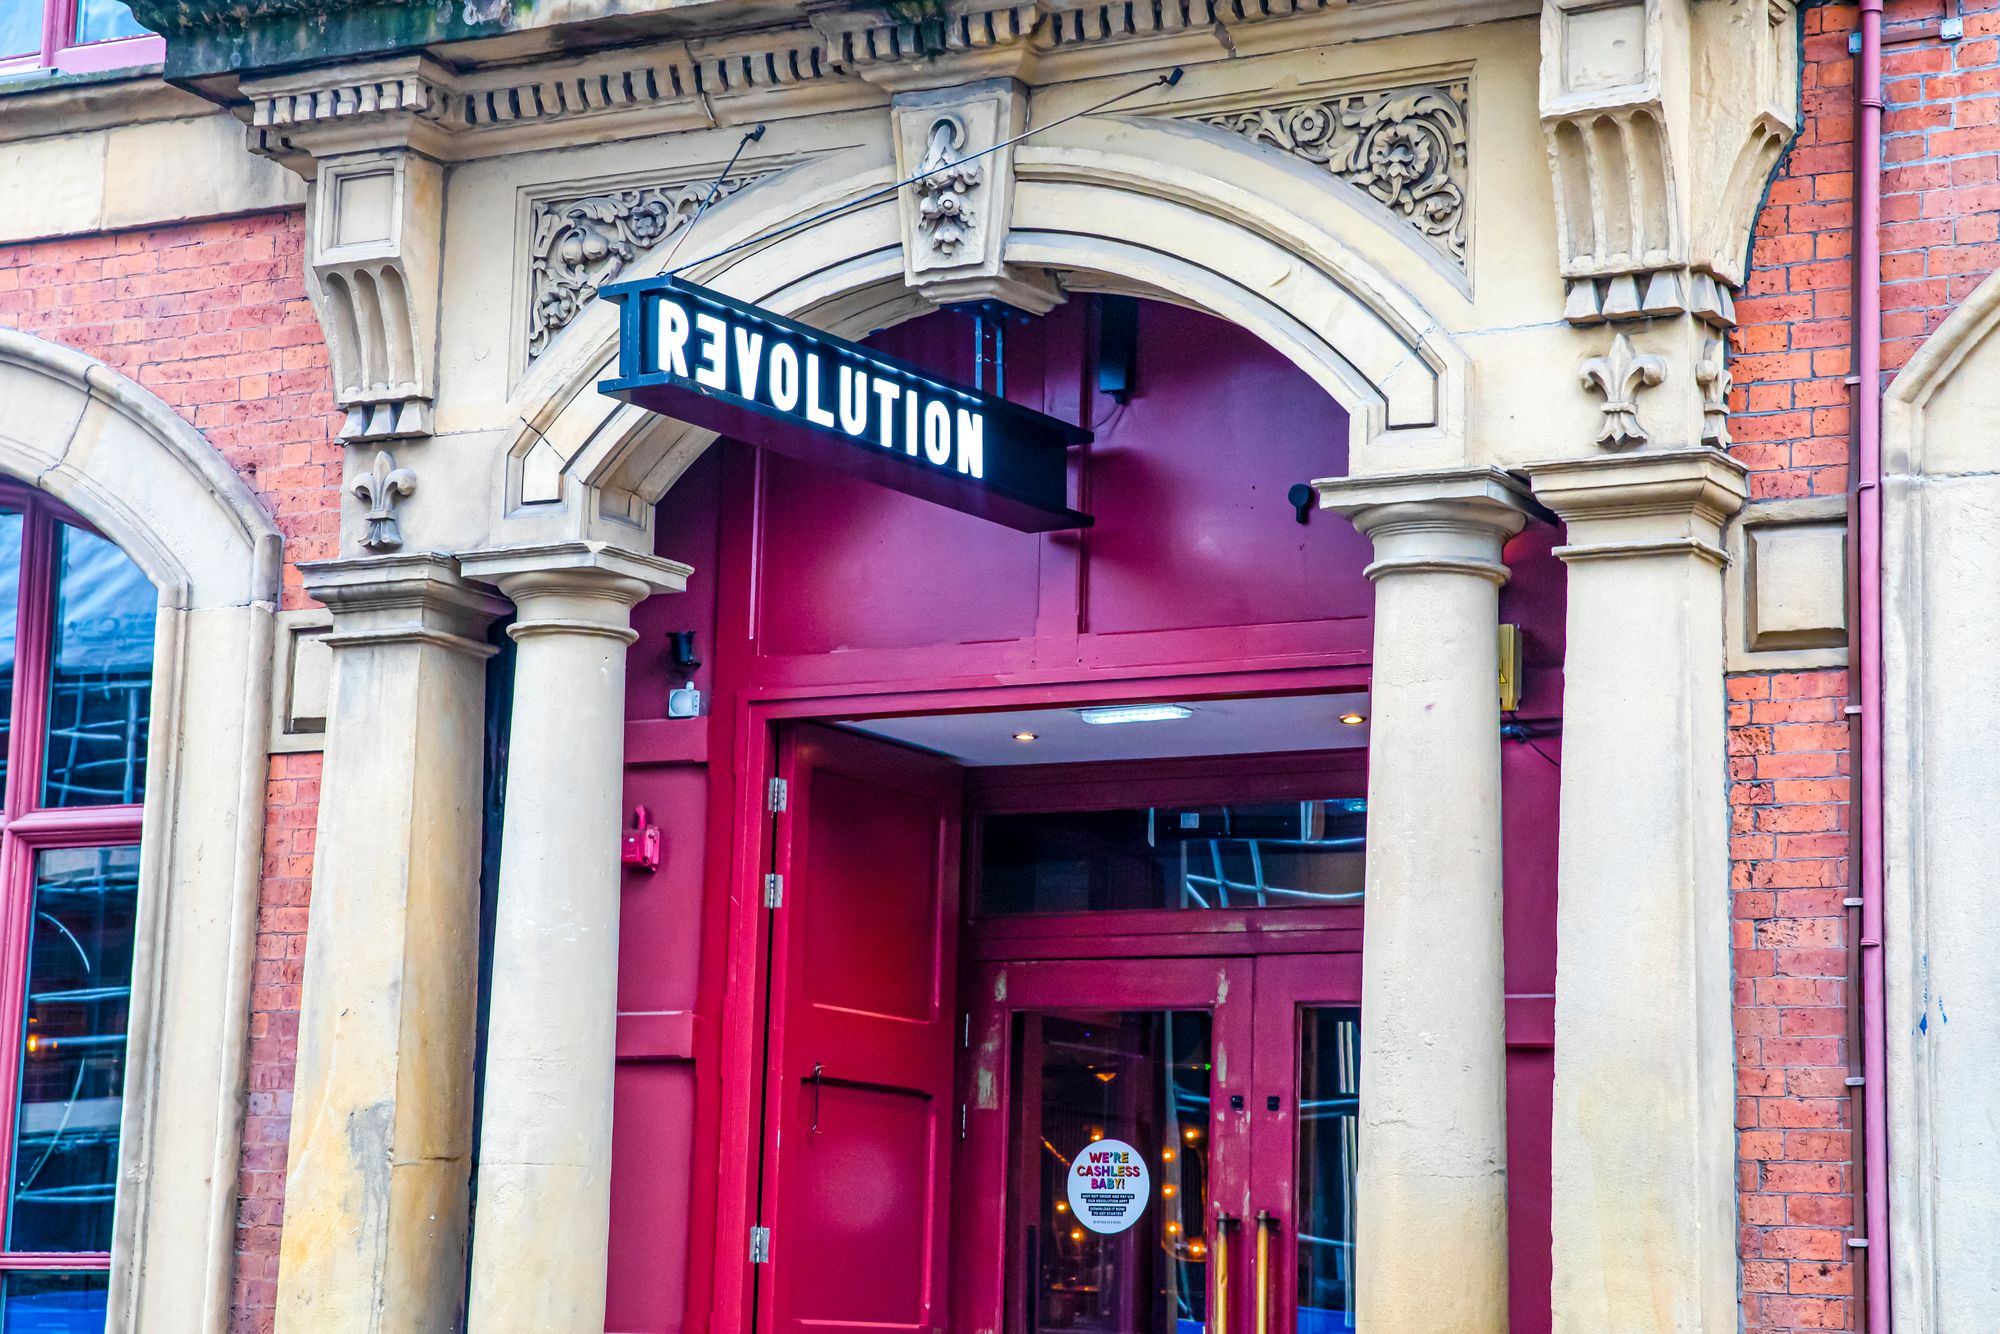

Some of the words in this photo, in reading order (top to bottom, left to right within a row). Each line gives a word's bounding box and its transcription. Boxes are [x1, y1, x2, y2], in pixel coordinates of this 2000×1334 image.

[657, 299, 984, 479] REVOLUTION
[1089, 1152, 1129, 1163] WE'RE
[1076, 1165, 1140, 1177] CASHLESS
[1091, 1178, 1125, 1190] BABY!
